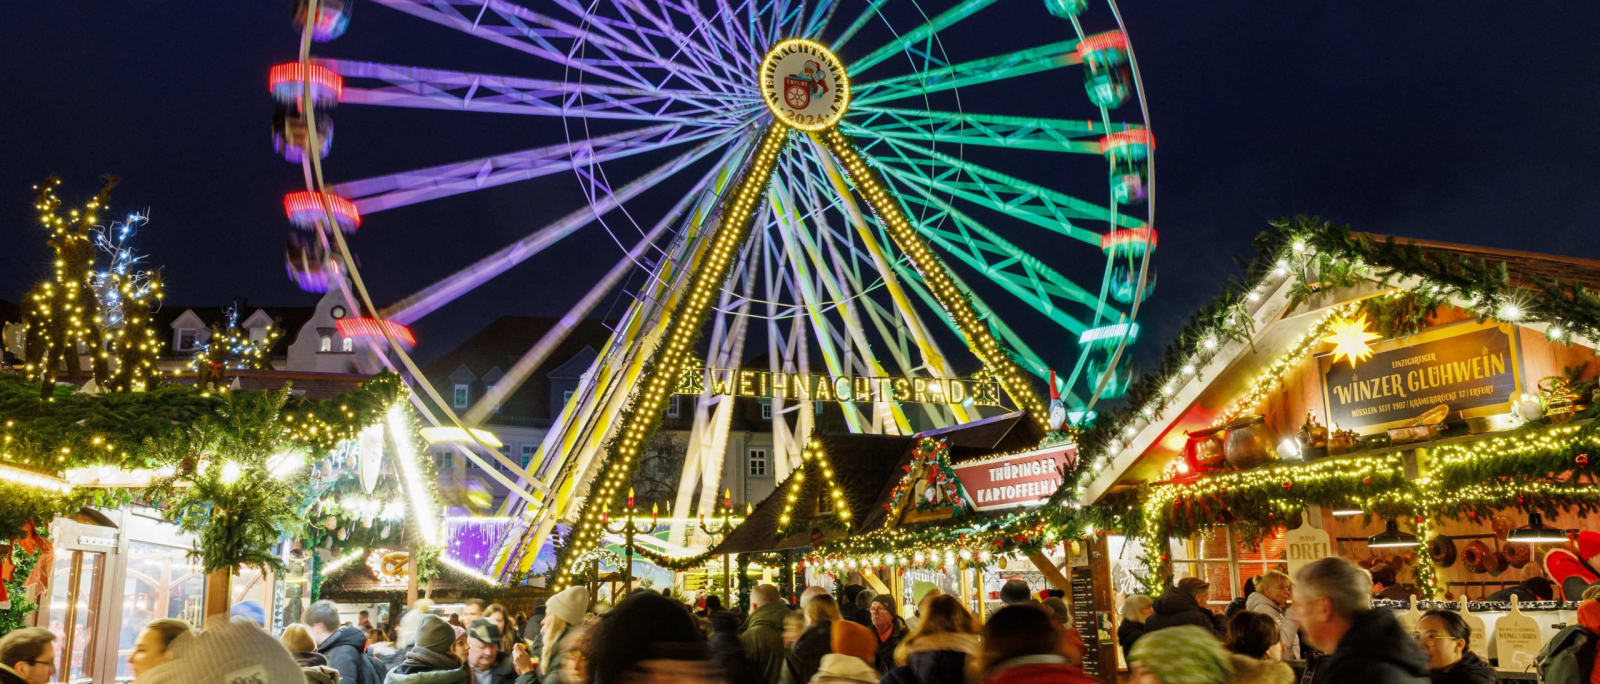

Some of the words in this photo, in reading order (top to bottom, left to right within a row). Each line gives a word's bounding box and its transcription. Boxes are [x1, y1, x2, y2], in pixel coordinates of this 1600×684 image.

[765, 44, 844, 115] WEIHNACHTSMARKT
[787, 110, 825, 125] 2024
[709, 368, 966, 404] WEIHNACHTSRAD
[1333, 373, 1408, 405] WINZER
[1407, 351, 1506, 392] GLÜHWEIN
[1469, 385, 1495, 398] ERFURT
[988, 457, 1057, 482] THÜRINGER
[977, 477, 1062, 502] KARTOFFELHA
